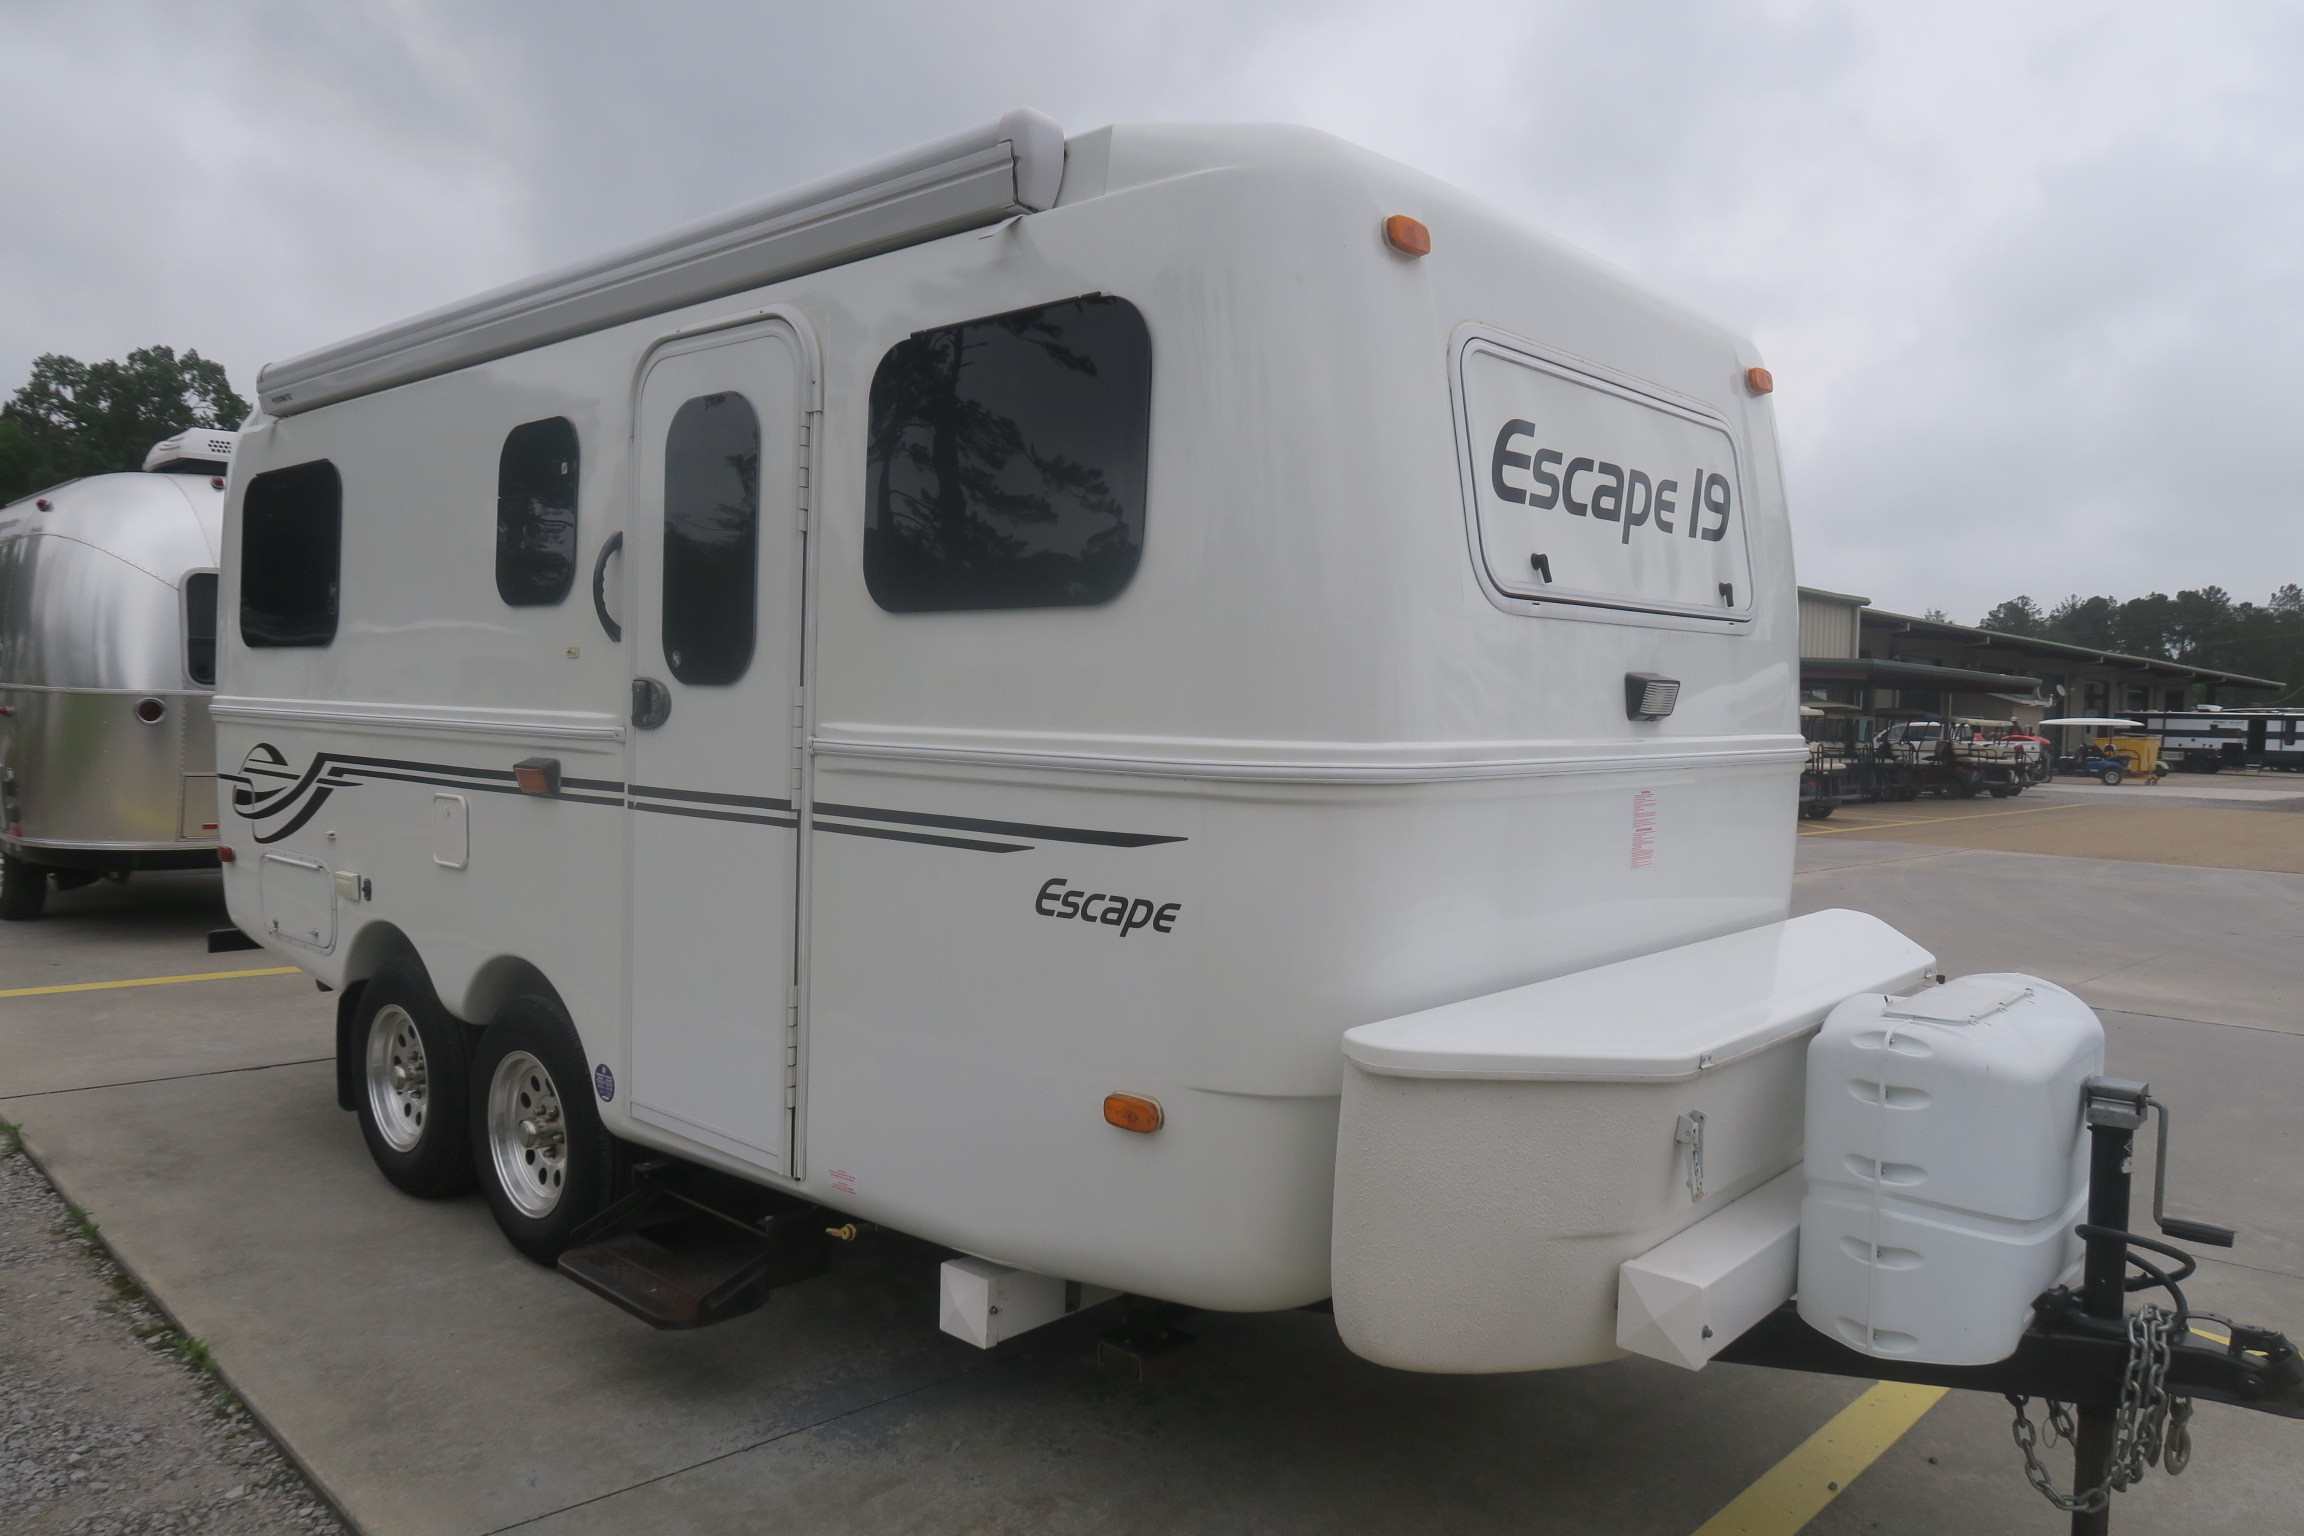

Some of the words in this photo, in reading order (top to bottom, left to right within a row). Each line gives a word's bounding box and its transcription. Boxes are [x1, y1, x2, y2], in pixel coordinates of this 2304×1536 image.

[1491, 418, 1678, 545] Escape
[1688, 467, 1731, 542] 19
[1035, 877, 1182, 938] Escape
